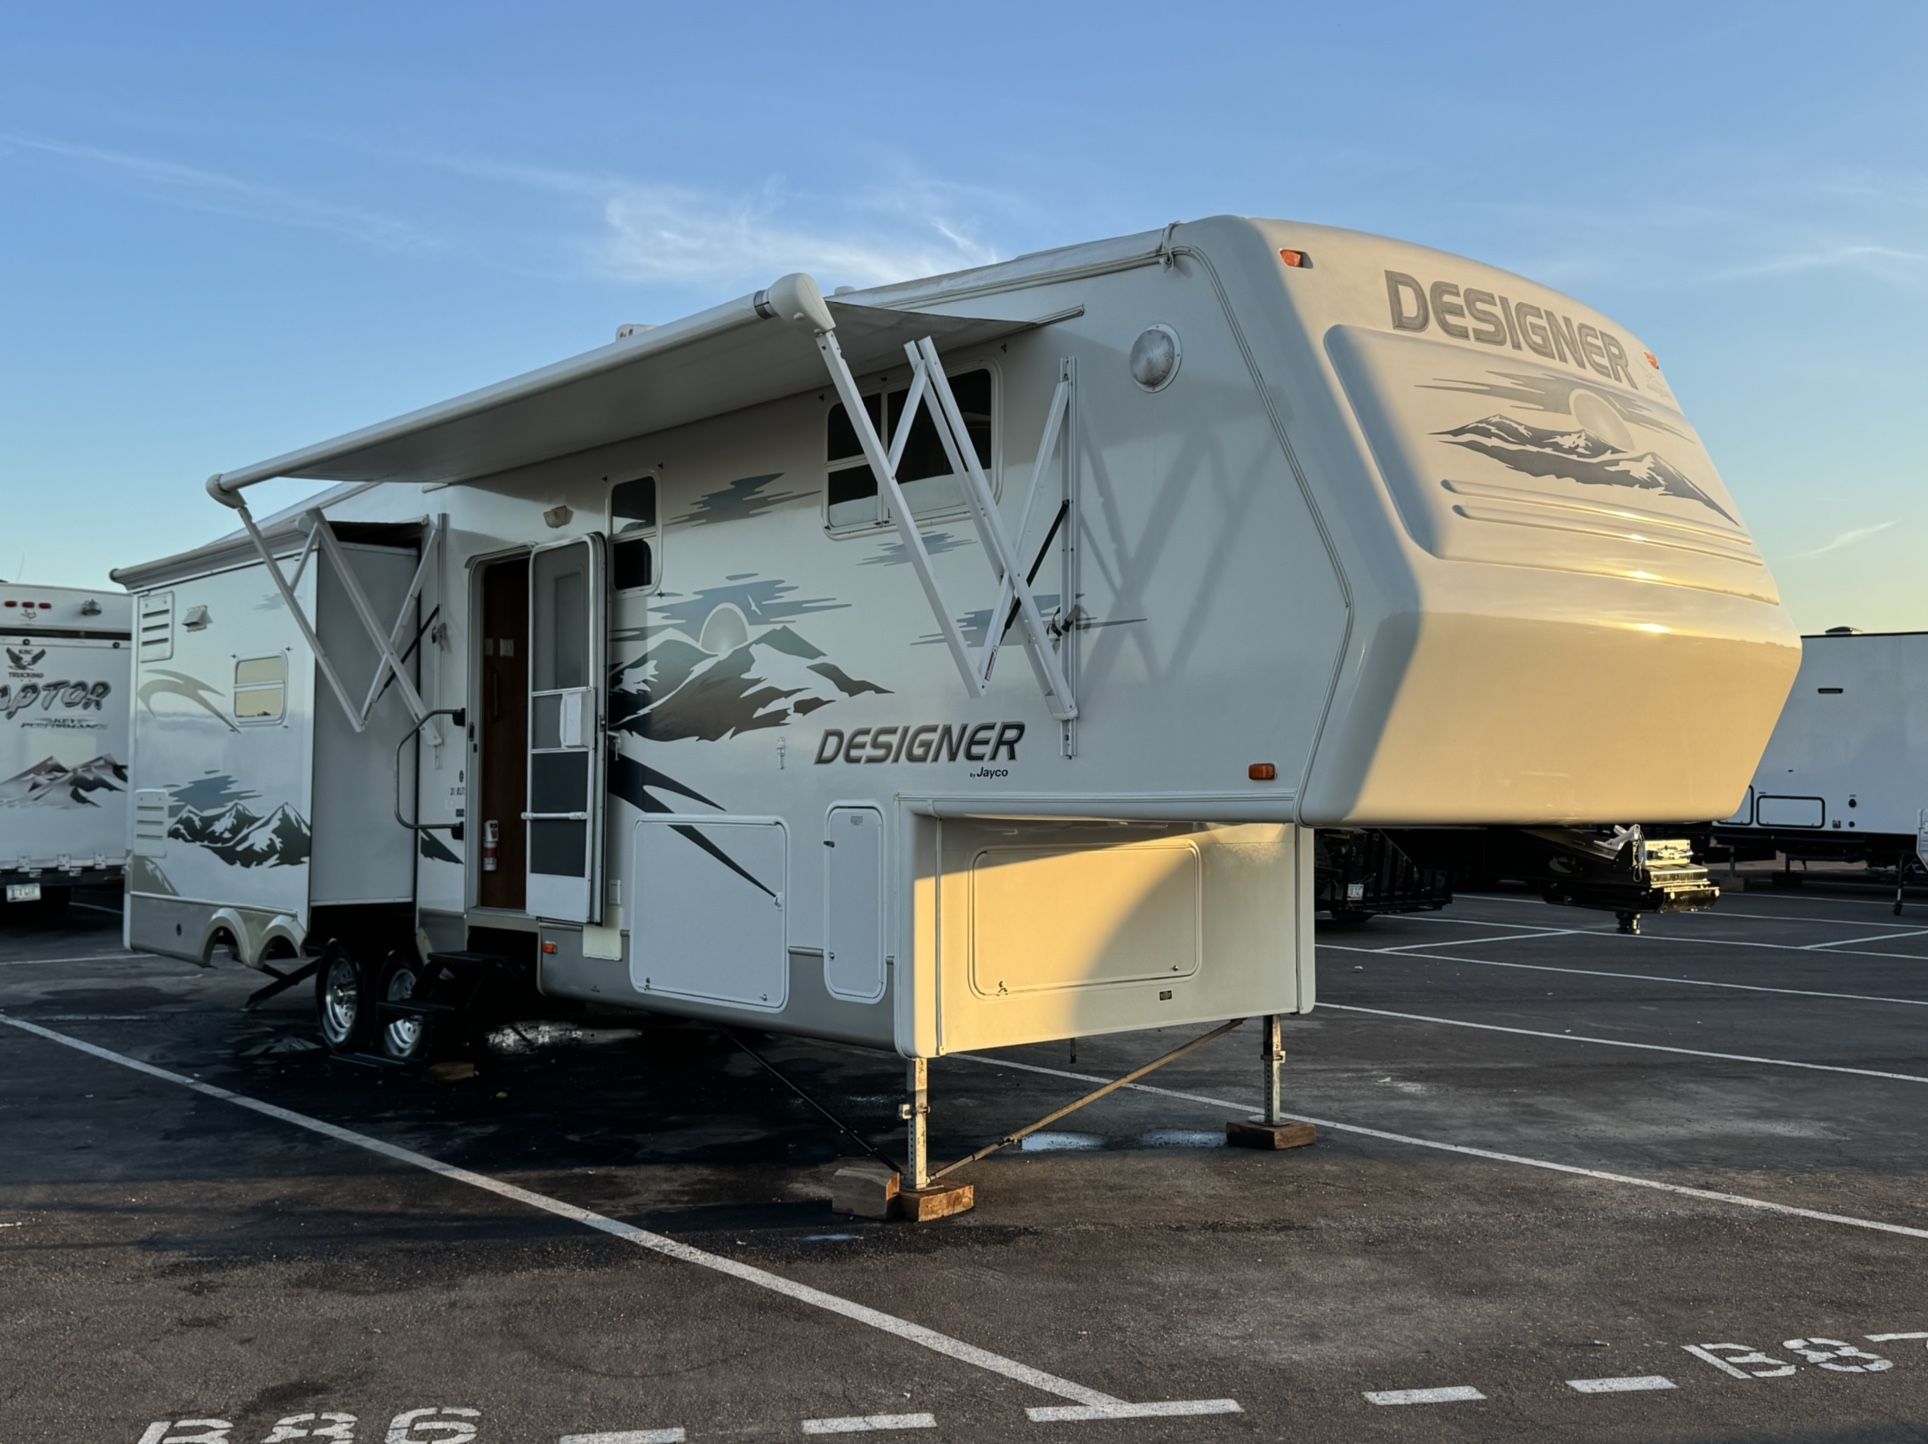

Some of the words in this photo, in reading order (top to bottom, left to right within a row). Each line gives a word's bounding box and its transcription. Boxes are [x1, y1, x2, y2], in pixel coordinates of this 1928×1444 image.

[1384, 269, 1640, 390] DESIGNER
[0, 680, 111, 720] PTOR
[814, 721, 1026, 765] DESIGNER
[976, 767, 1009, 779] Jayco
